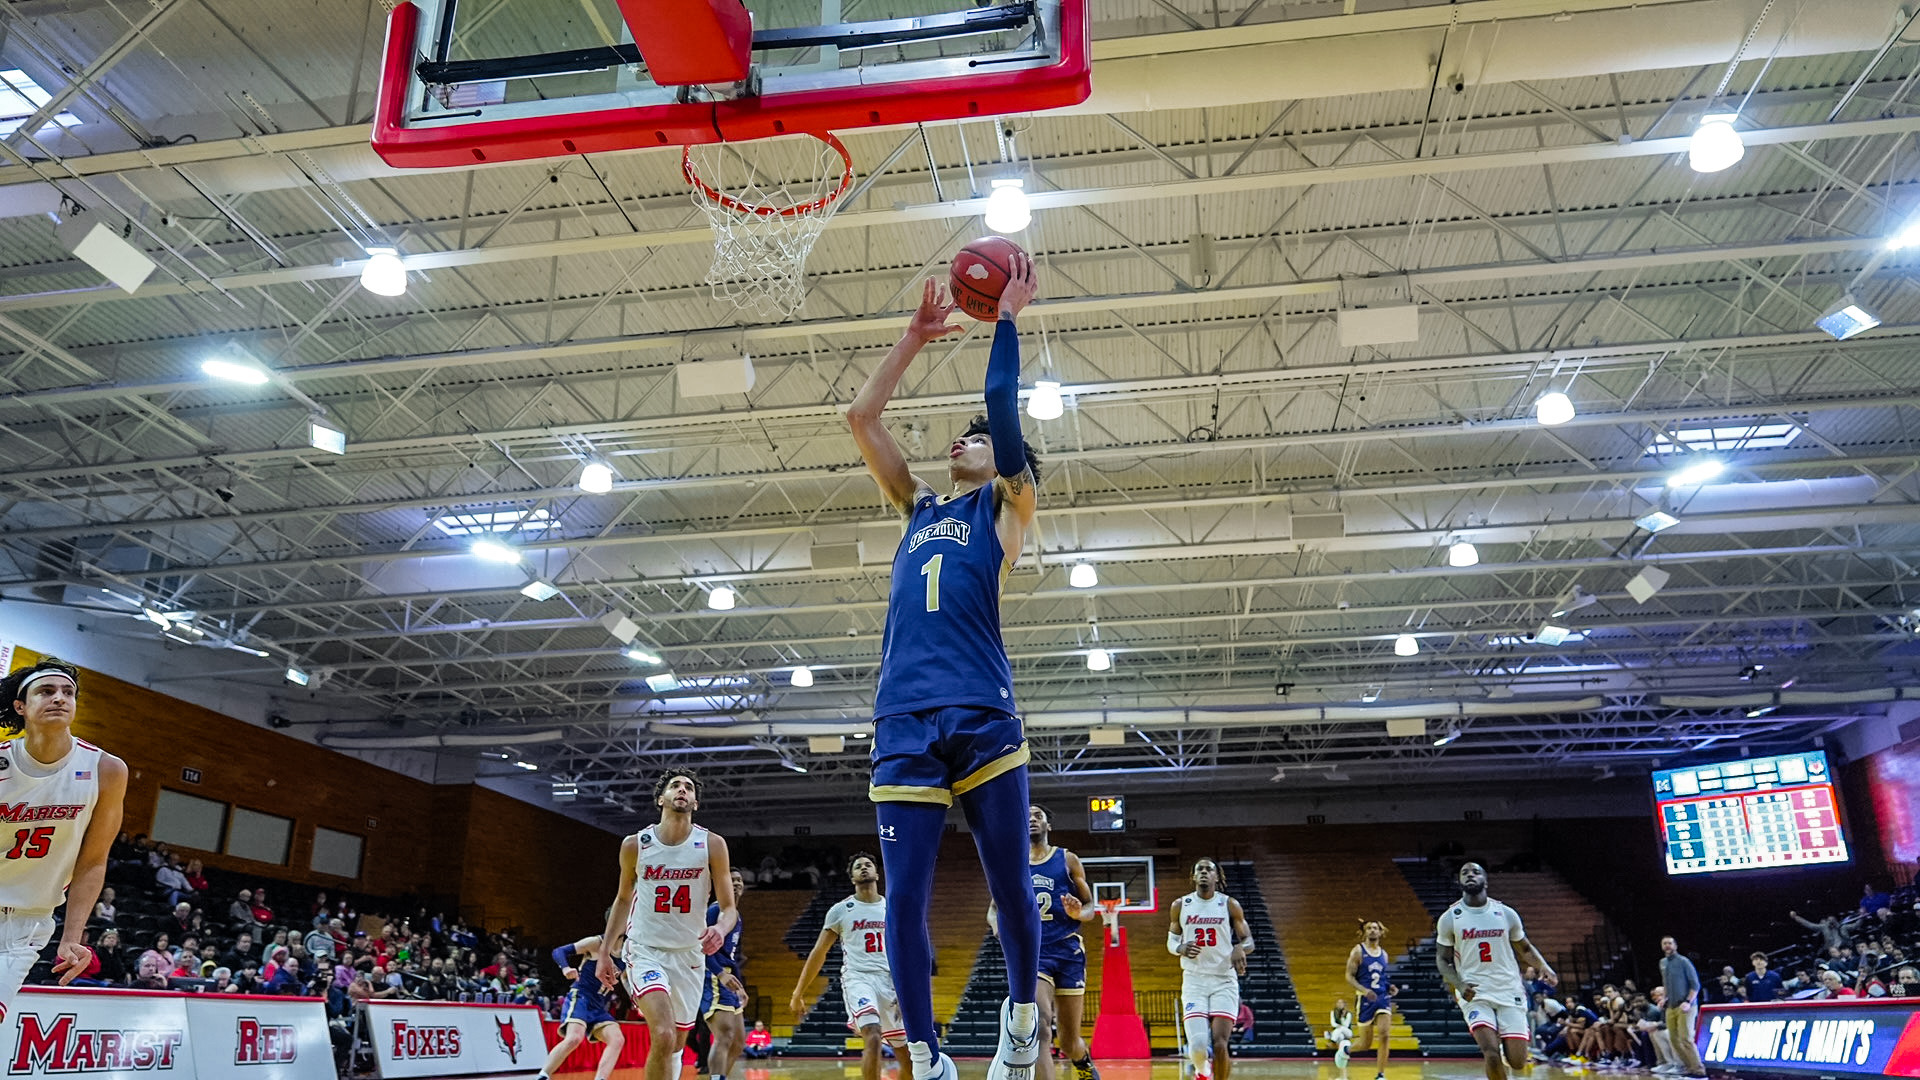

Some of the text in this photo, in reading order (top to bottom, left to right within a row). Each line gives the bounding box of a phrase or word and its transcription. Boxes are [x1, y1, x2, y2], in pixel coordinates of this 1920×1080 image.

[910, 522, 970, 549] THE MOUNT
[921, 553, 943, 612] 1
[185, 769, 200, 782] 114
[0, 802, 85, 823] MARIST
[5, 826, 56, 859] 15
[643, 864, 704, 881] MARIST
[655, 885, 691, 914] 24
[851, 919, 887, 931] MARIS
[1185, 915, 1225, 925] MARIST
[864, 932, 884, 953] 21
[1195, 928, 1217, 947] 23
[1462, 928, 1504, 940] MARIST
[1478, 942, 1492, 962] 2
[1371, 972, 1380, 989] 2
[7, 1012, 462, 1075] MARIST RED FOXES
[1704, 1015, 1875, 1065] 26 MOUNT ST. MARY'S
